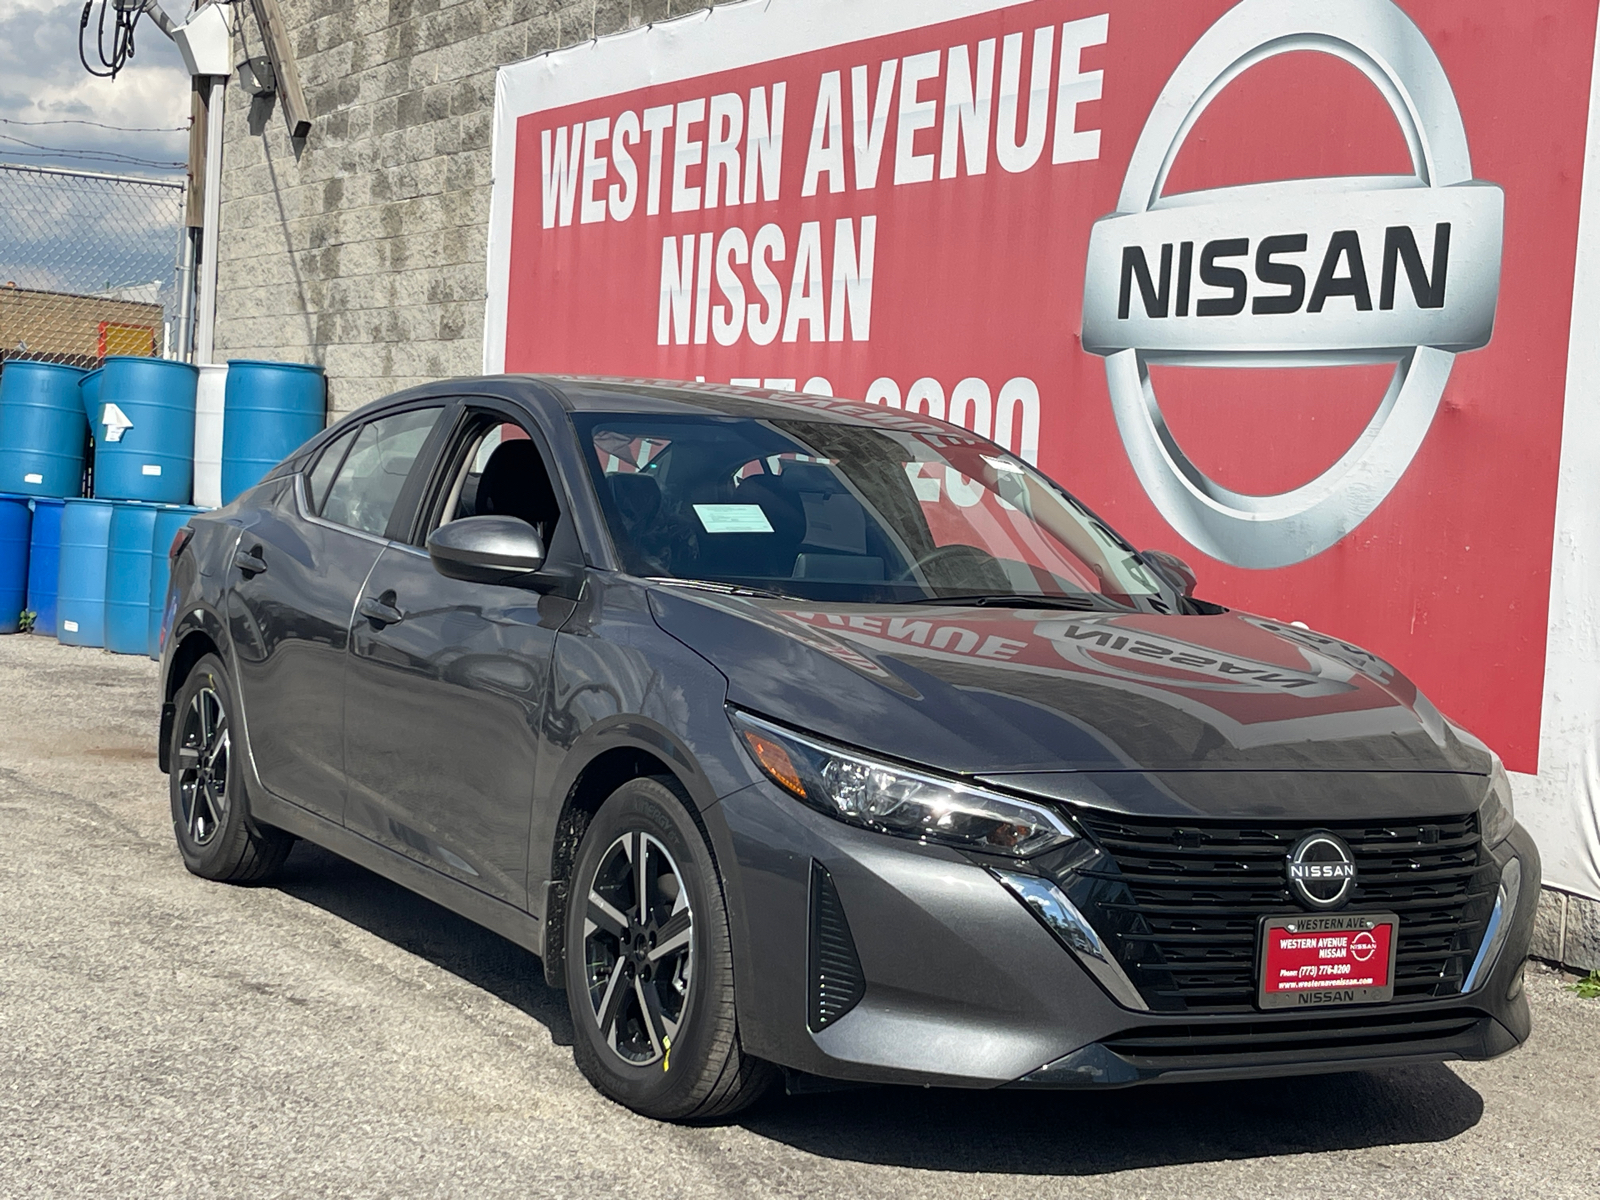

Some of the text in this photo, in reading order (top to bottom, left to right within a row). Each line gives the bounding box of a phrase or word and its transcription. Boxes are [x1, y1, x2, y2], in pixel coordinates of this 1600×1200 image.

[541, 13, 1110, 229] WESTERN AVENUE
[1117, 222, 1452, 319] NISSAN
[657, 215, 877, 346] NISSAN
[1291, 865, 1353, 877] NISSAN
[1297, 918, 1343, 930] WESTERN
[1280, 937, 1348, 949] WESTERN AVENUE
[1318, 948, 1347, 959] NISSAN
[1298, 965, 1318, 978] (773)
[1318, 964, 1351, 975] 776-8200
[1298, 990, 1354, 1004] NISSAN
